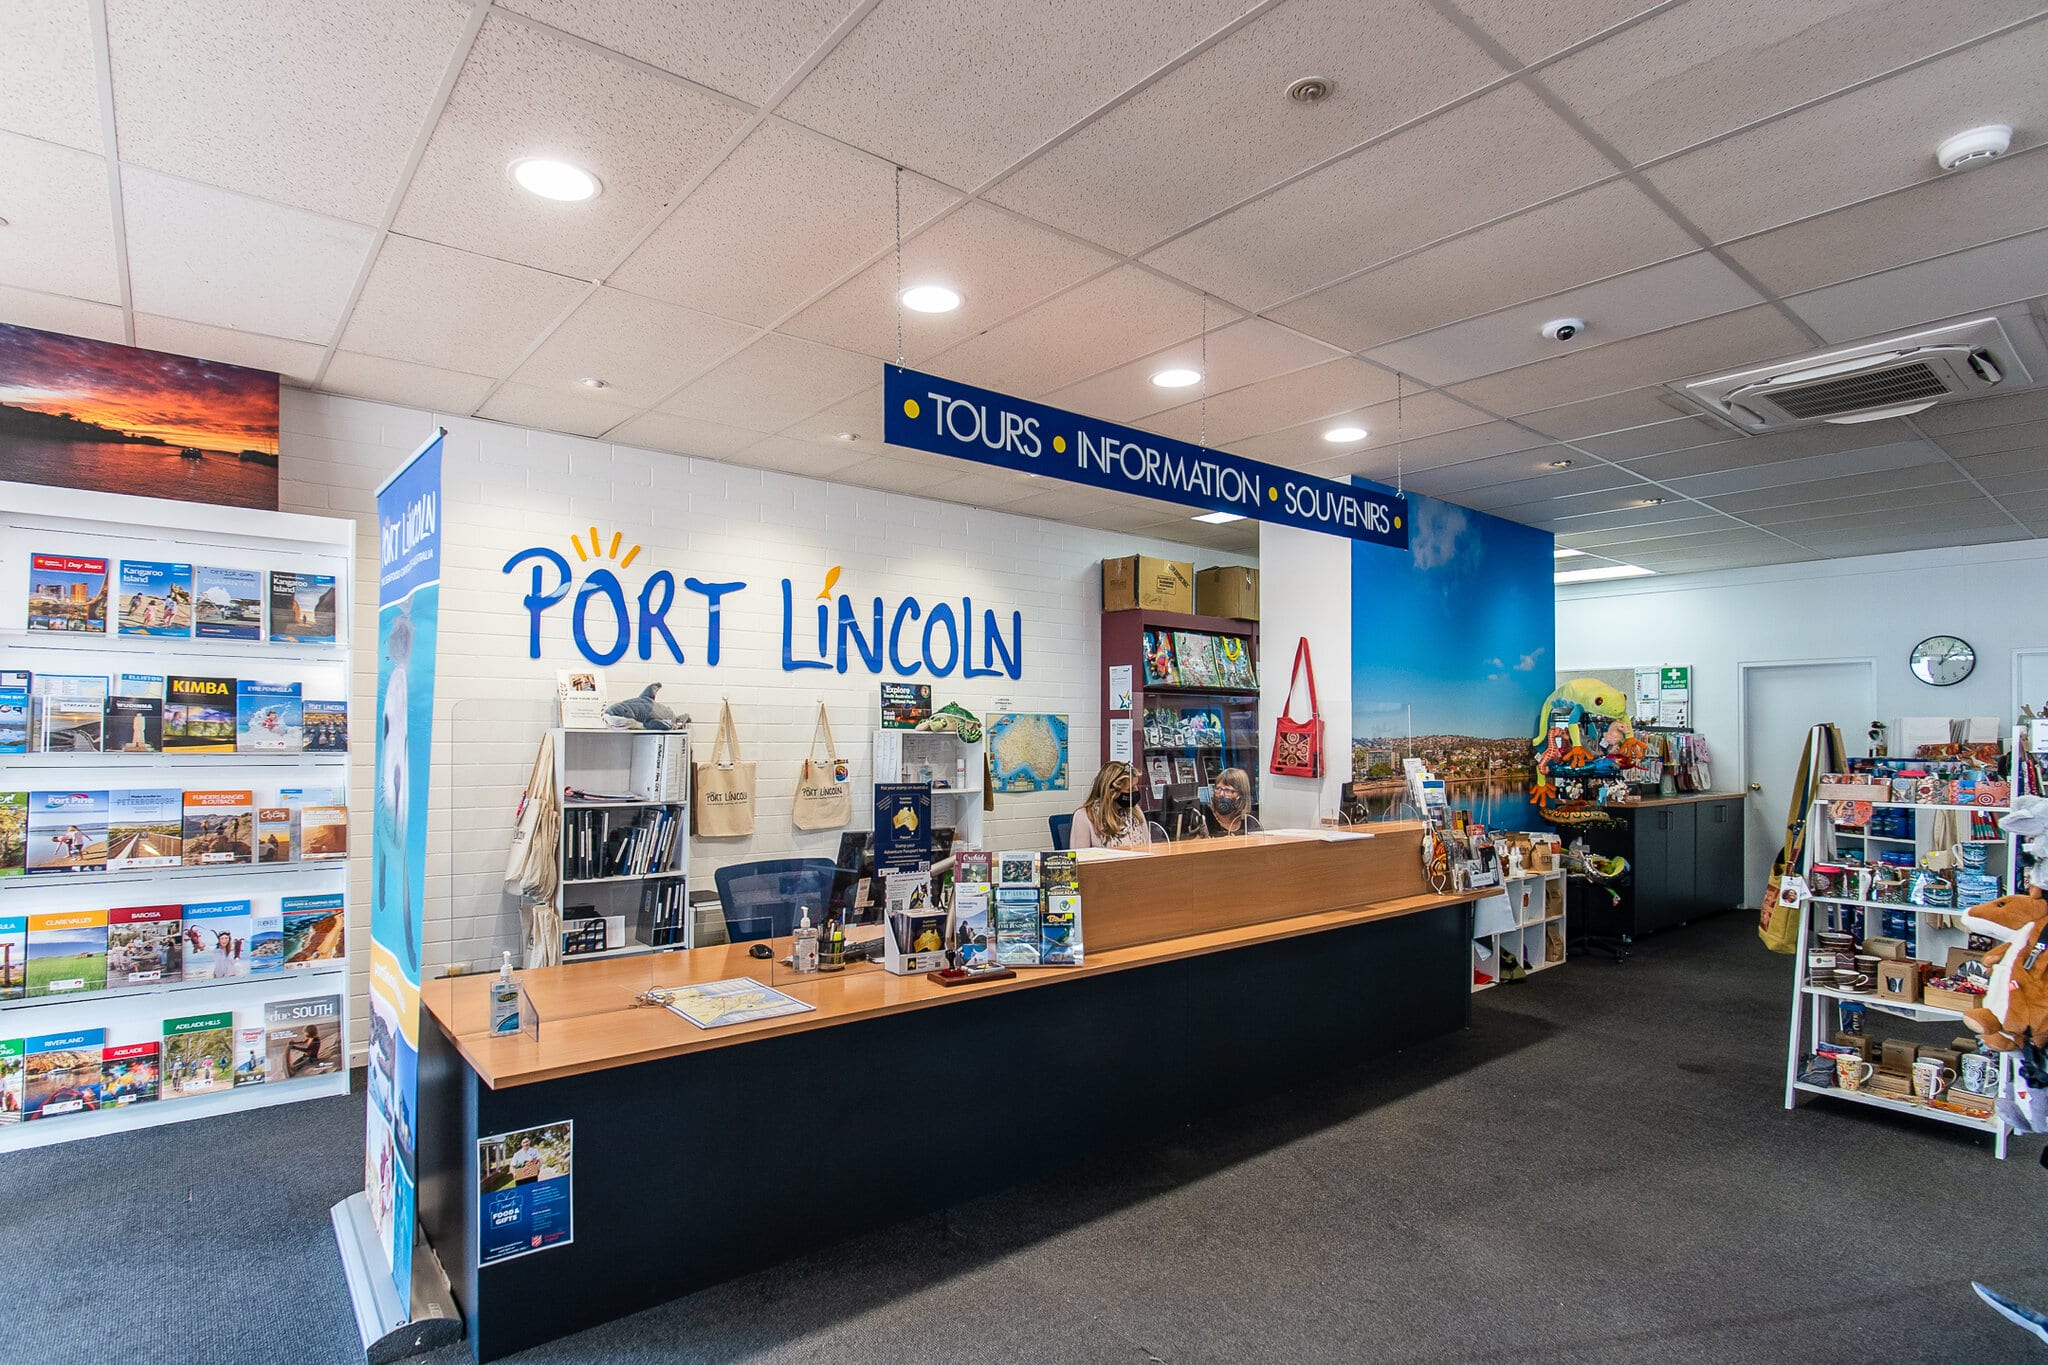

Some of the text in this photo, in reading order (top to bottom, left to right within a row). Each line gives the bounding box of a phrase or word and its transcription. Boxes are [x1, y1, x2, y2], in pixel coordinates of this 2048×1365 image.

[928, 391, 1390, 534] TOURS INFORMATION SOUVENIRS
[67, 561, 83, 569] Day
[123, 567, 164, 577] Kangaroo
[123, 575, 149, 583] Island
[273, 577, 308, 588] Kangaroo
[273, 585, 295, 593] Island
[503, 547, 1022, 681] PORT LINCOLN
[173, 679, 229, 695] KIMBA
[885, 686, 911, 695] Explore
[802, 786, 843, 797] PORT LINCOLN
[705, 792, 722, 802] PORT
[963, 853, 987, 861] Orchids
[131, 911, 161, 919] BAROSSA
[268, 1003, 333, 1023] due SOUTH
[175, 1021, 205, 1030] ADELAIDE
[44, 1036, 84, 1047] RIVERLAND
[113, 1047, 143, 1056] ADELAIDE
[492, 1209, 514, 1220] FOOD
[495, 1215, 518, 1225] GIFTS
